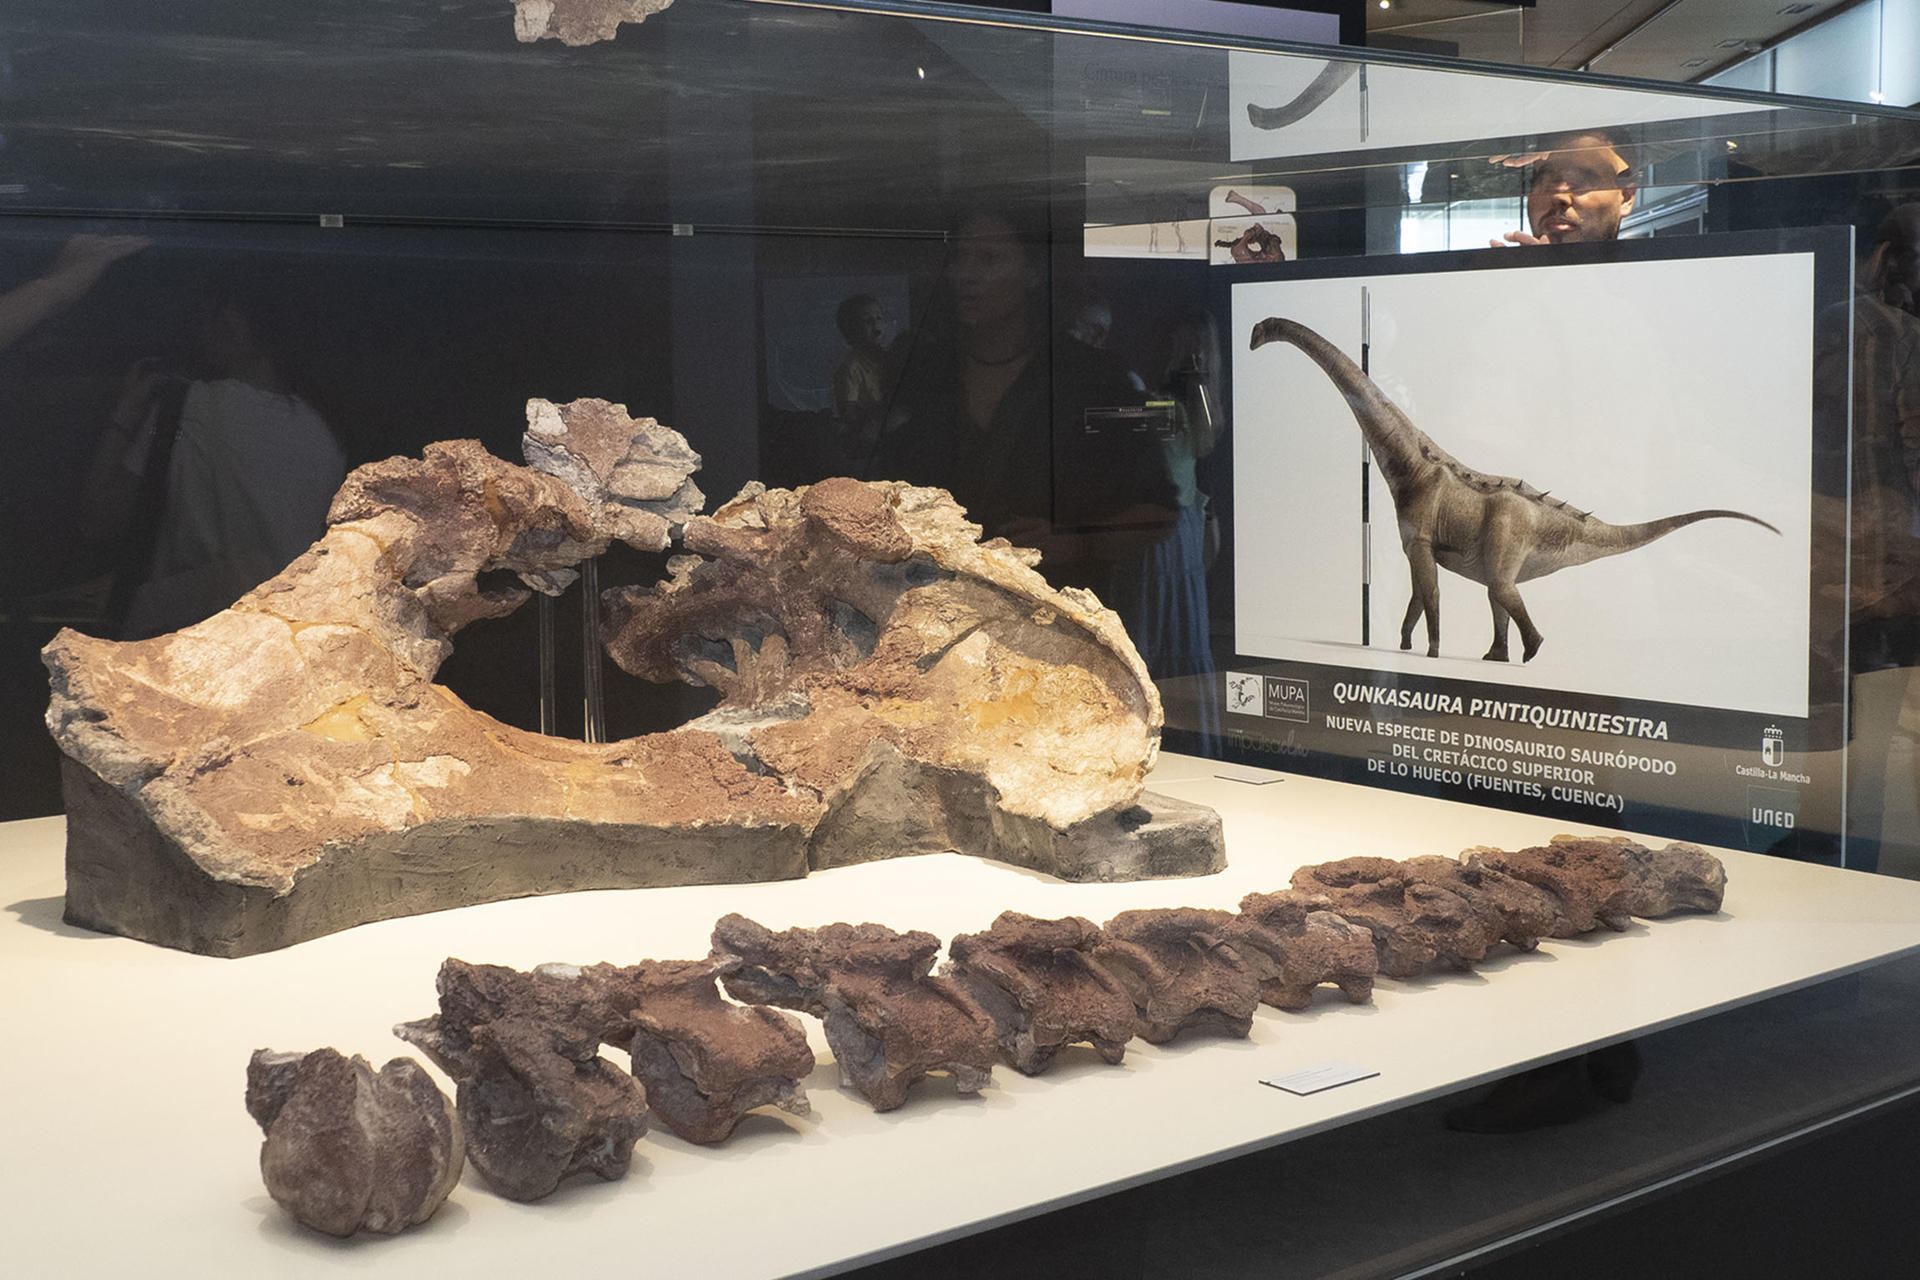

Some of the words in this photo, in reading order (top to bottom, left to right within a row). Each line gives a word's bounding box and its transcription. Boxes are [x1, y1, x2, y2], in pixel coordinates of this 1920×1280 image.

[1268, 684, 1305, 703] MUPA
[1333, 682, 1463, 715] QUNKASAURA
[1469, 698, 1669, 740] PINTIQUINIESTRA
[1326, 715, 1372, 734] NUEVA
[1376, 722, 1436, 742] ESPECIE
[1440, 730, 1460, 745] DE
[1464, 733, 1566, 761] DINOSAURIO
[1571, 748, 1677, 776] SAURÓPODO
[1392, 743, 1420, 760] DEL
[1423, 748, 1508, 772] CRETÁCICO
[1512, 760, 1595, 785] SUPERIOR
[1367, 758, 1386, 773] DE
[1390, 761, 1408, 776] LO
[1413, 765, 1462, 785] HUECO
[1467, 773, 1546, 801] (FUENTES,
[1551, 786, 1624, 814] CUENCA)
[1780, 771, 1811, 784] Mancha
[1752, 807, 1795, 829] UNED
